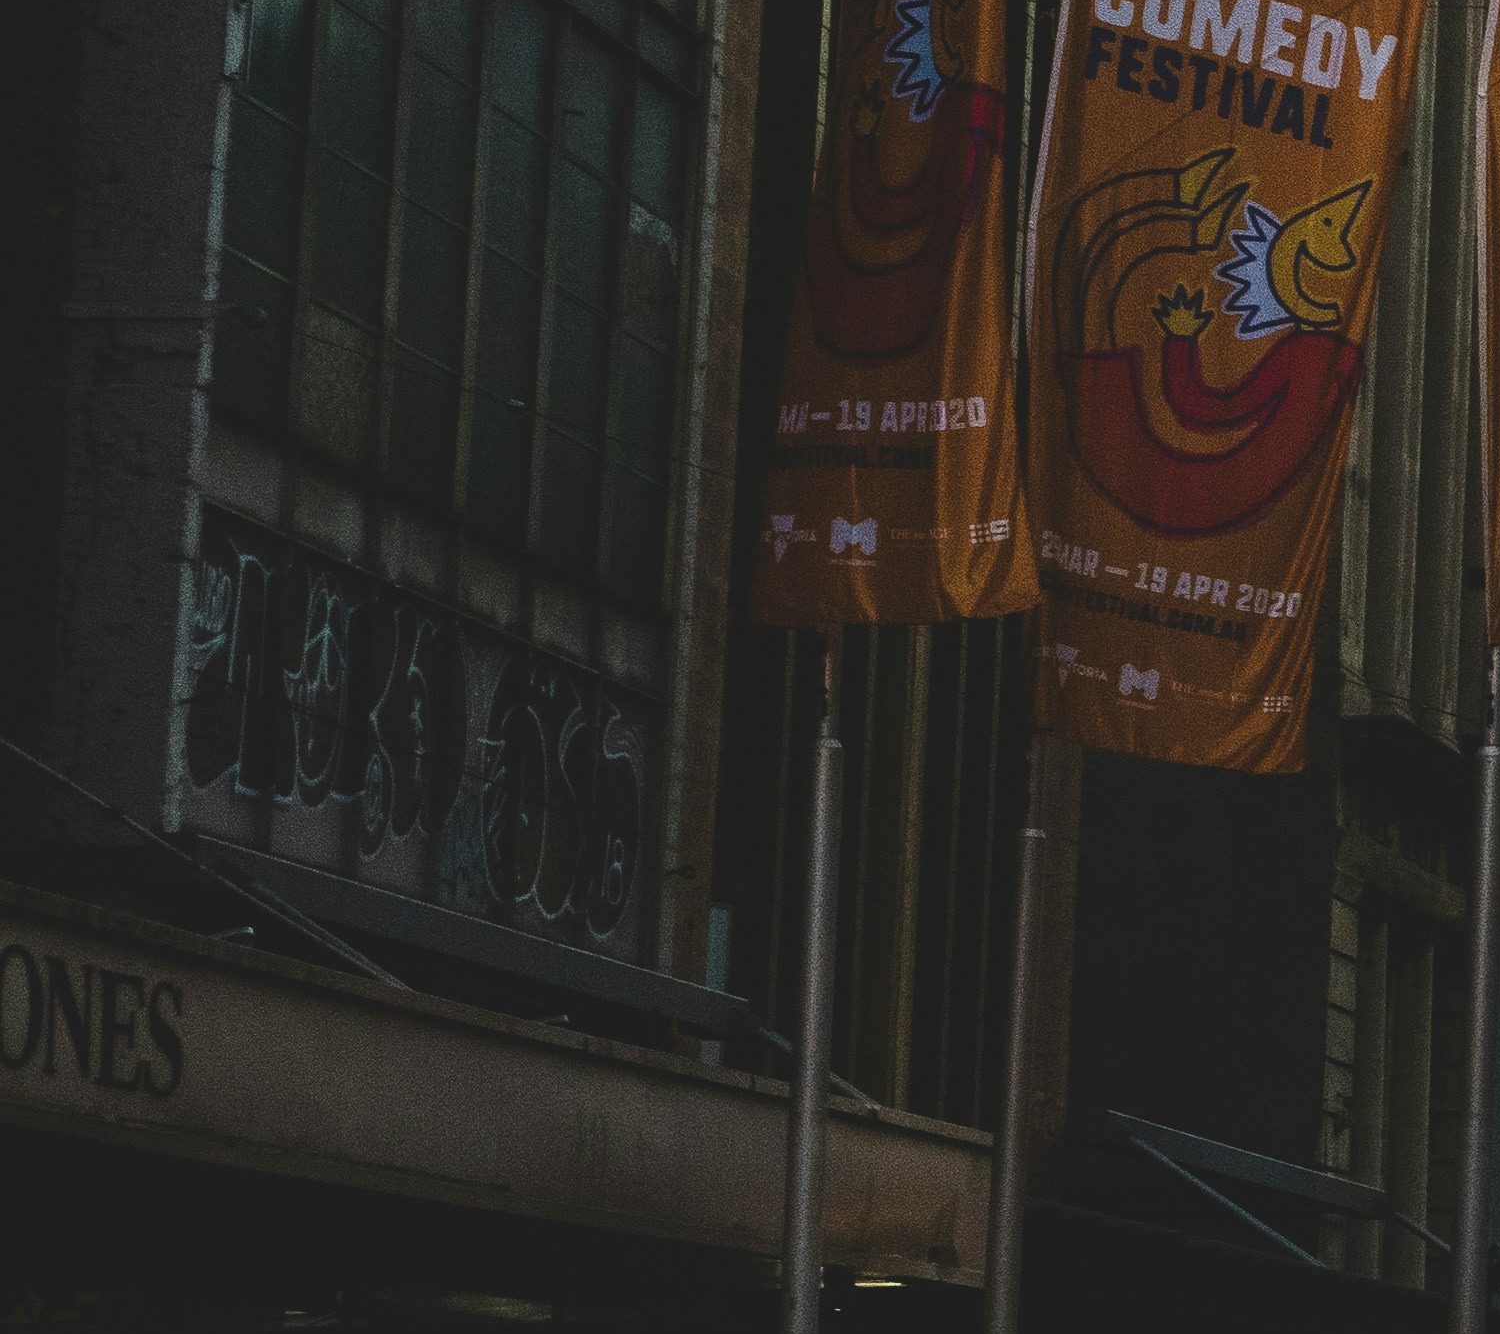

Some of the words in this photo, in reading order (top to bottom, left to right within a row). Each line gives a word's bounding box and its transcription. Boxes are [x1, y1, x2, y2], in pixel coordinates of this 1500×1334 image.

[1084, 26, 1333, 149] FESTIVAL
[836, 399, 872, 432] 19
[1135, 562, 1168, 594] 19
[1172, 571, 1231, 608] APR
[1235, 582, 1302, 619] 2020
